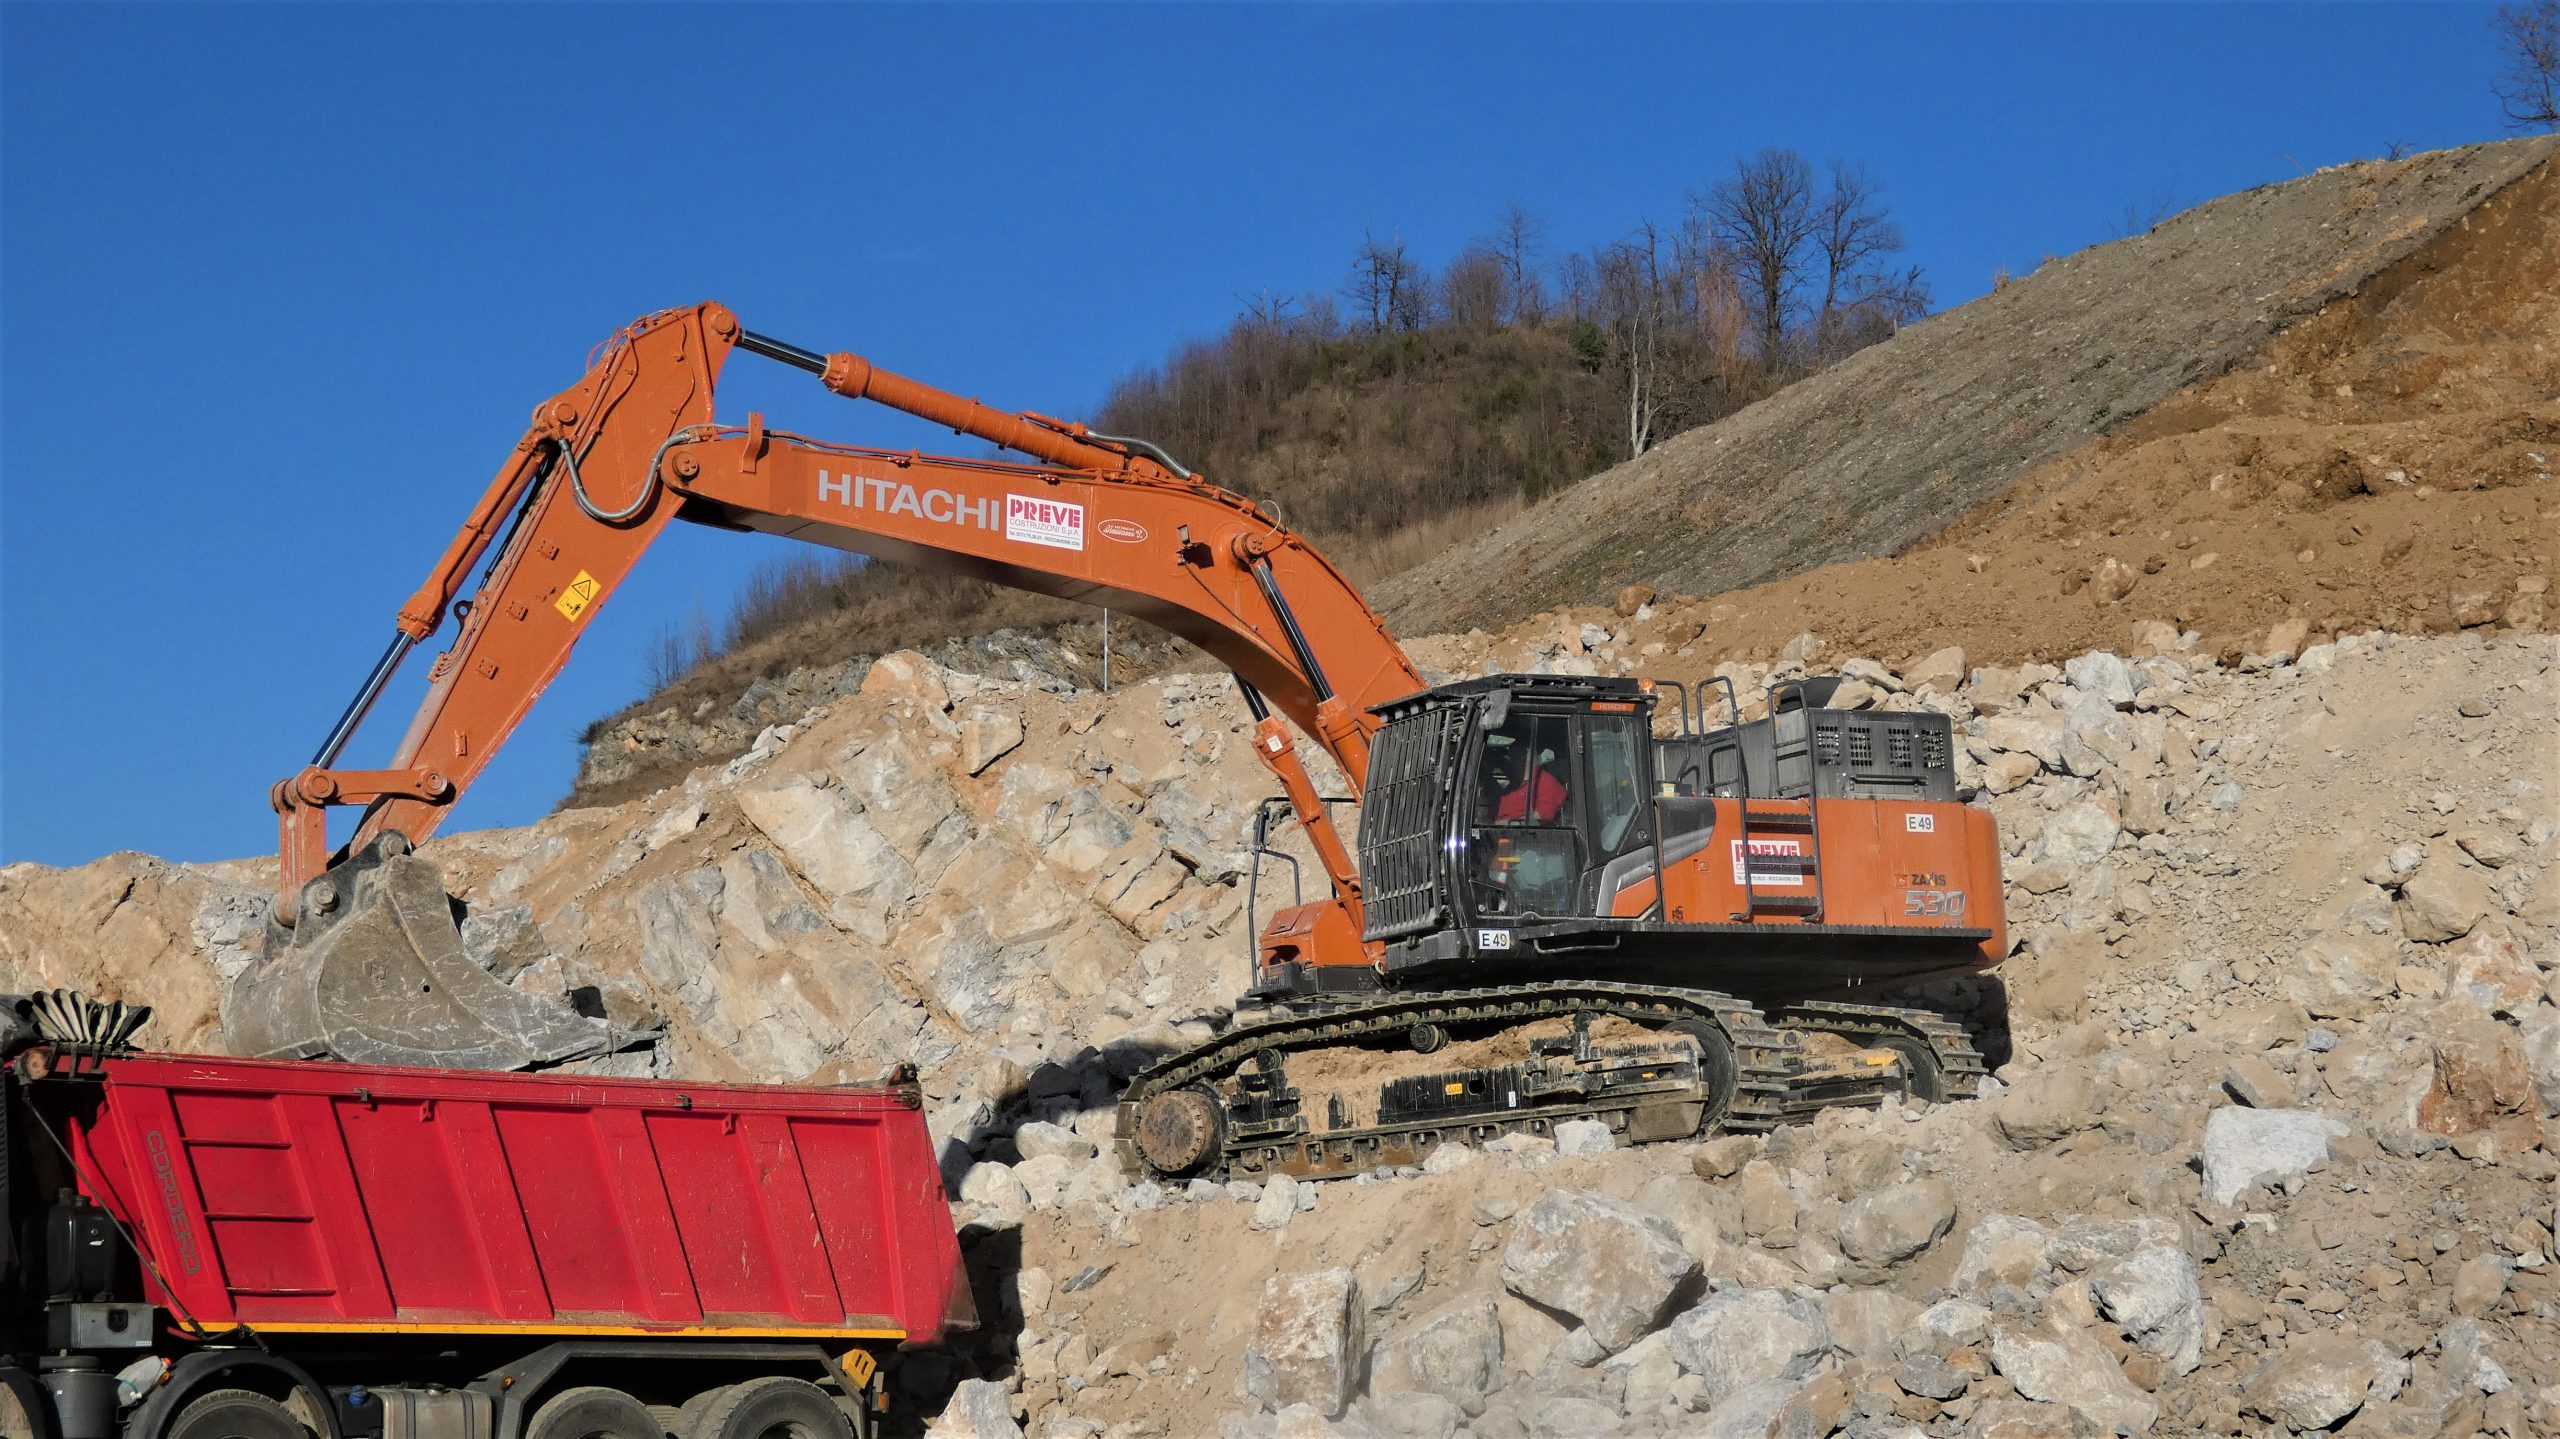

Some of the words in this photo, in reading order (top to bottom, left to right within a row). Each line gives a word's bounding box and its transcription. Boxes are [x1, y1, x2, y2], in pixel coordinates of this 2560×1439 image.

[818, 469, 1000, 532] HITACHI
[1010, 498, 1081, 529] PREVE
[1009, 518, 1060, 533] COSTRUZIONI
[1908, 816, 1917, 830] E
[1918, 817, 1932, 830] 49
[1911, 871, 1947, 887] ZAXIS
[1904, 890, 1966, 917] 530
[1482, 933, 1490, 947] E
[1492, 933, 1507, 947] 49
[147, 1130, 201, 1275] CORDERO
